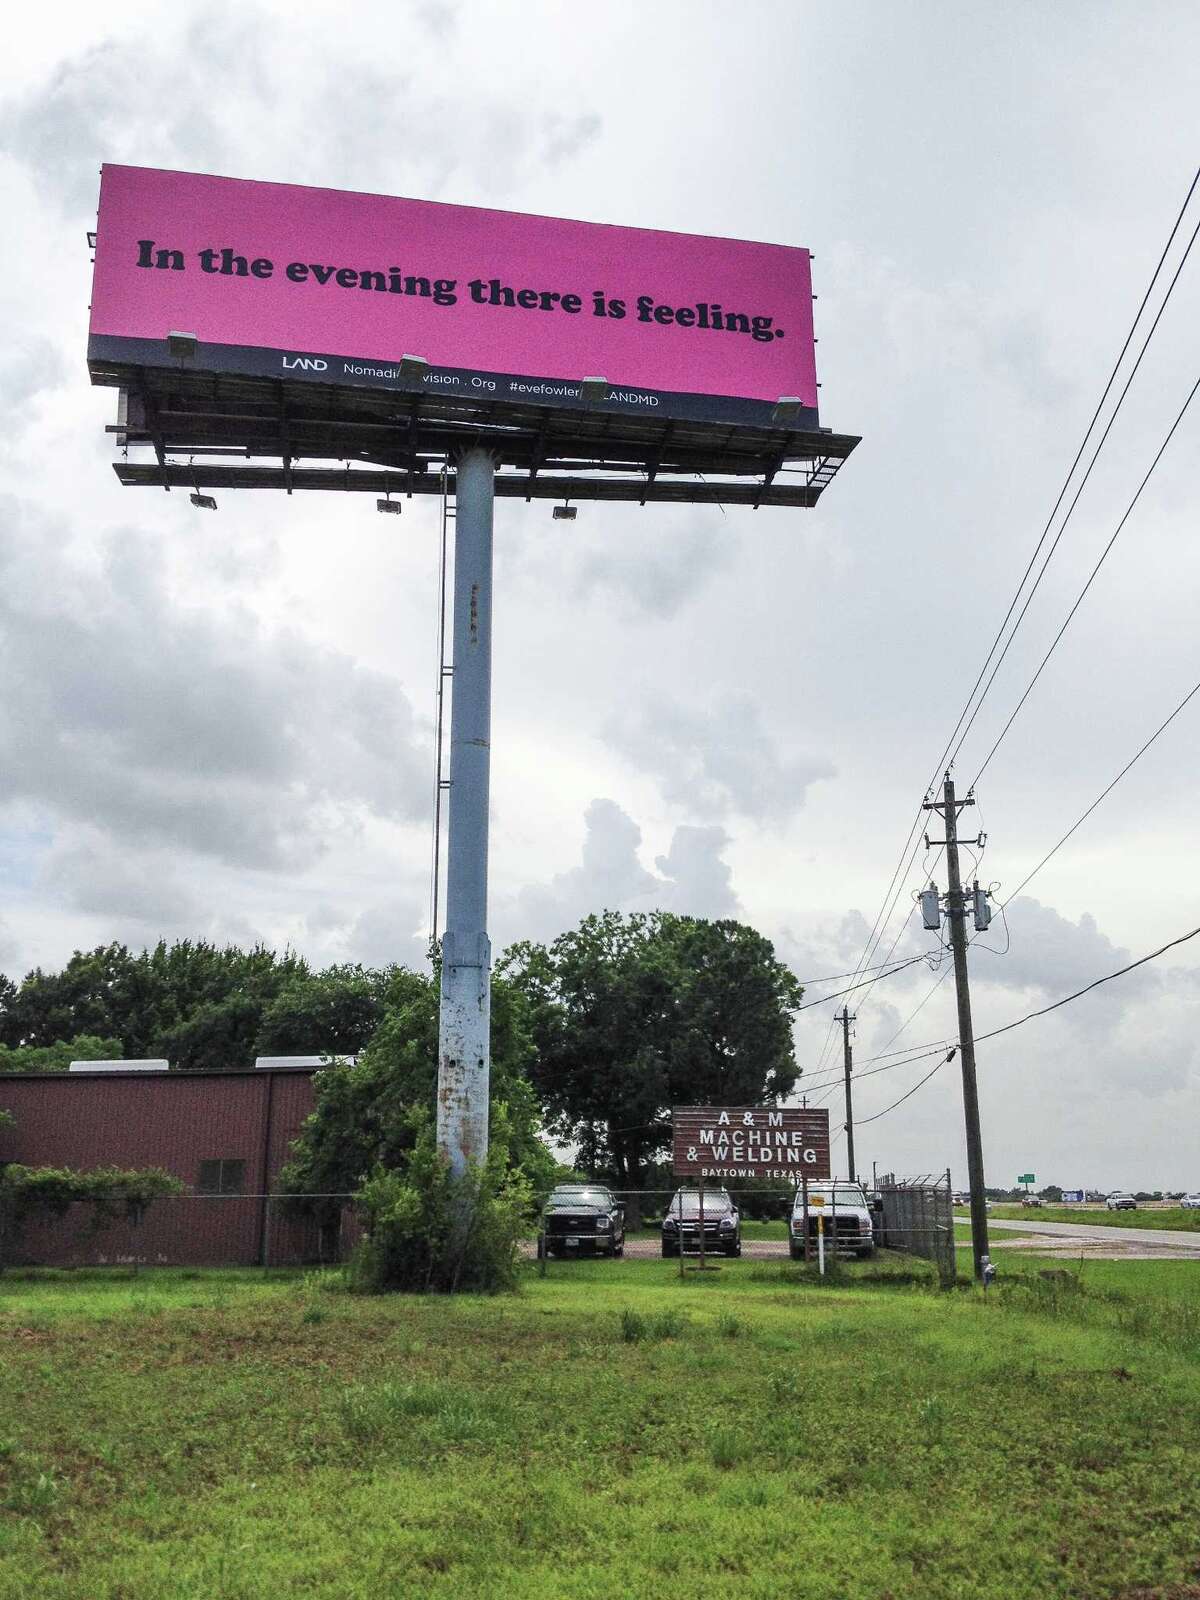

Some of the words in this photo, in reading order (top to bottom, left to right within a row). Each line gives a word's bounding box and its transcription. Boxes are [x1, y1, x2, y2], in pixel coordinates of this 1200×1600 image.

[136, 240, 185, 271] In
[198, 247, 273, 279] the
[286, 261, 457, 306] evening
[468, 278, 582, 314] there
[592, 290, 626, 319] is
[637, 295, 785, 342] feeling.
[282, 356, 328, 371] LAND
[343, 363, 399, 379] Nomadi
[509, 382, 580, 397] #evefowler
[718, 1111, 730, 1126] A
[742, 1111, 755, 1127] &
[769, 1112, 783, 1127] M
[699, 1129, 803, 1146] MACHINE
[686, 1146, 699, 1162] &
[712, 1146, 817, 1163] WELDING
[701, 1168, 755, 1178] BAYTOWN
[765, 1169, 803, 1178] TEXAS
